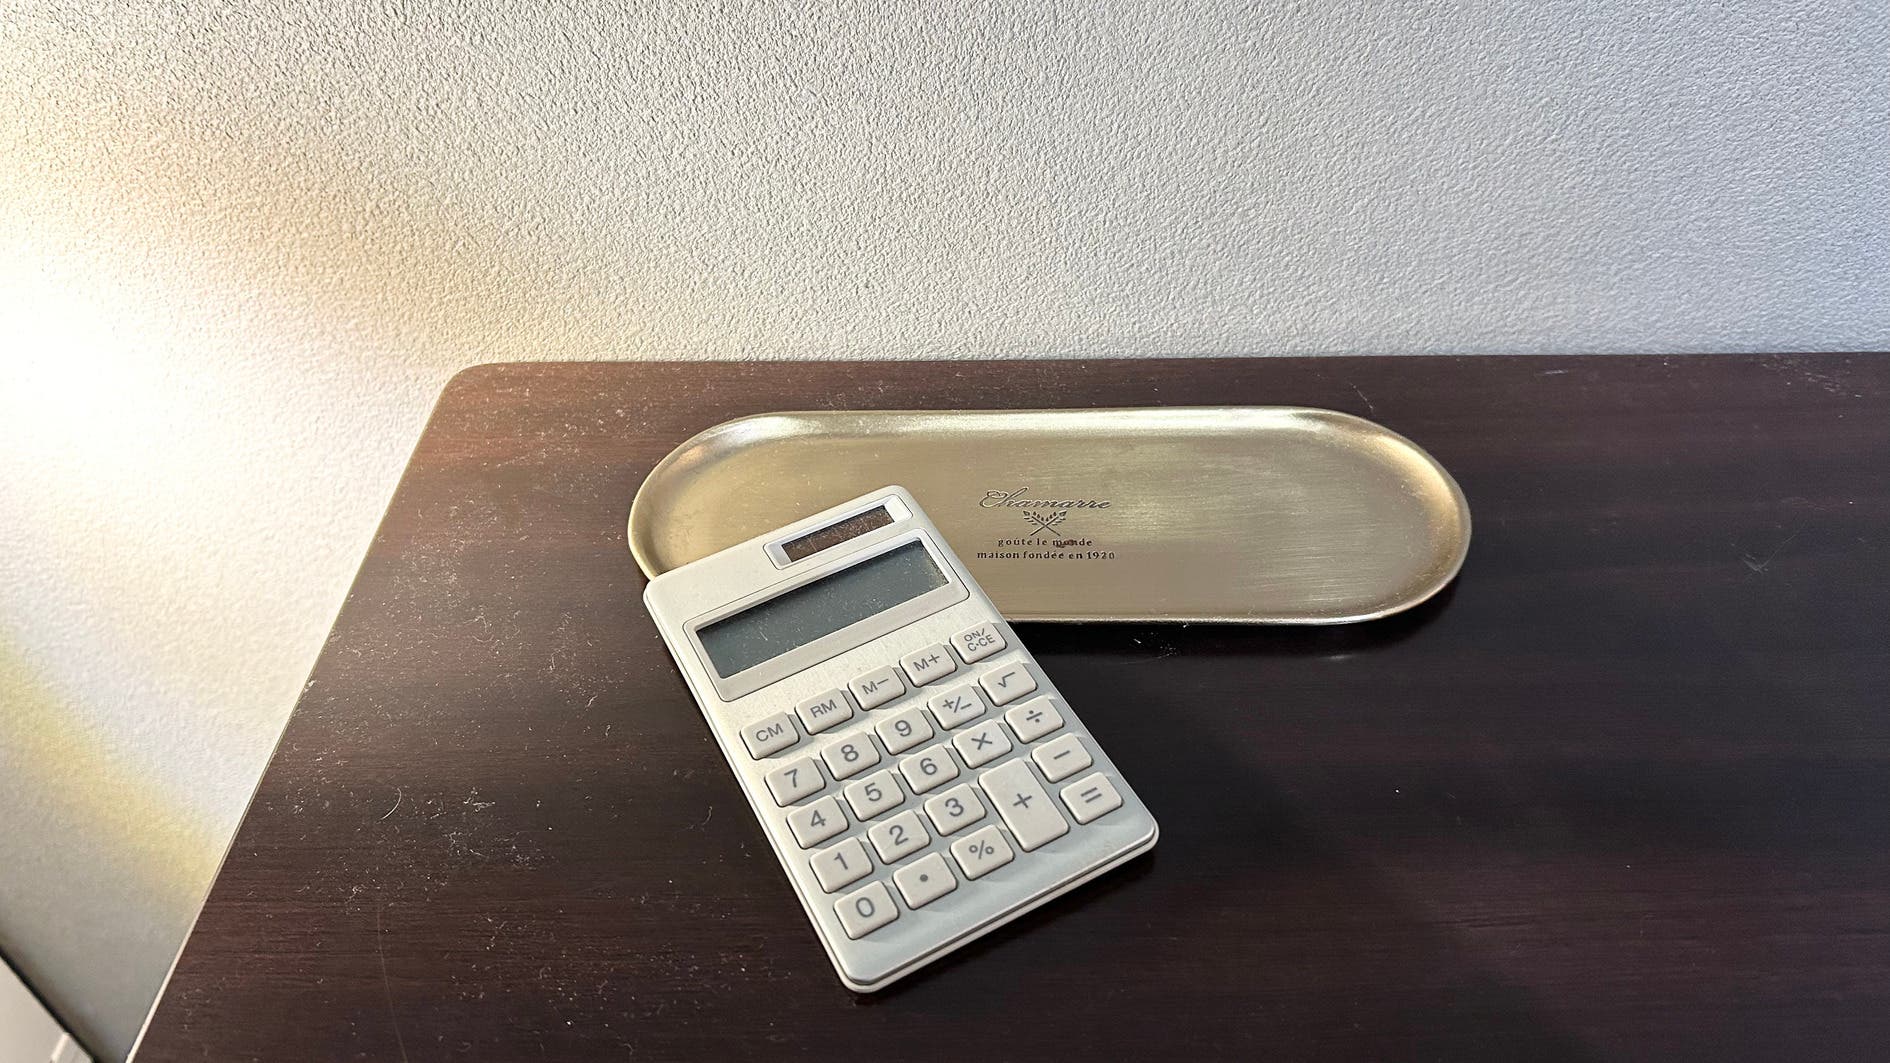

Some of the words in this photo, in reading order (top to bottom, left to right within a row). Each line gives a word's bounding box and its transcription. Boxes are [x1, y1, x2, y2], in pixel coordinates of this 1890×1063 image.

[979, 486, 1112, 509] Chamarre
[1037, 538, 1048, 546] le
[1052, 538, 1093, 547] monde
[977, 551, 1020, 559] maison
[1023, 550, 1065, 559] fondée
[1086, 551, 1116, 560] 1920
[913, 653, 940, 672] M+
[810, 699, 838, 719] RM
[755, 722, 784, 742] CM
[894, 719, 912, 737] 9
[840, 743, 859, 763] 8
[919, 757, 938, 776] 6
[784, 768, 799, 788] 7
[864, 782, 882, 802] 5
[1013, 793, 1033, 809] +
[944, 797, 964, 818] 3
[810, 810, 826, 828] 4
[889, 824, 909, 846] 2
[968, 839, 995, 860] %
[834, 852, 849, 871] 1
[855, 896, 875, 918] 0
